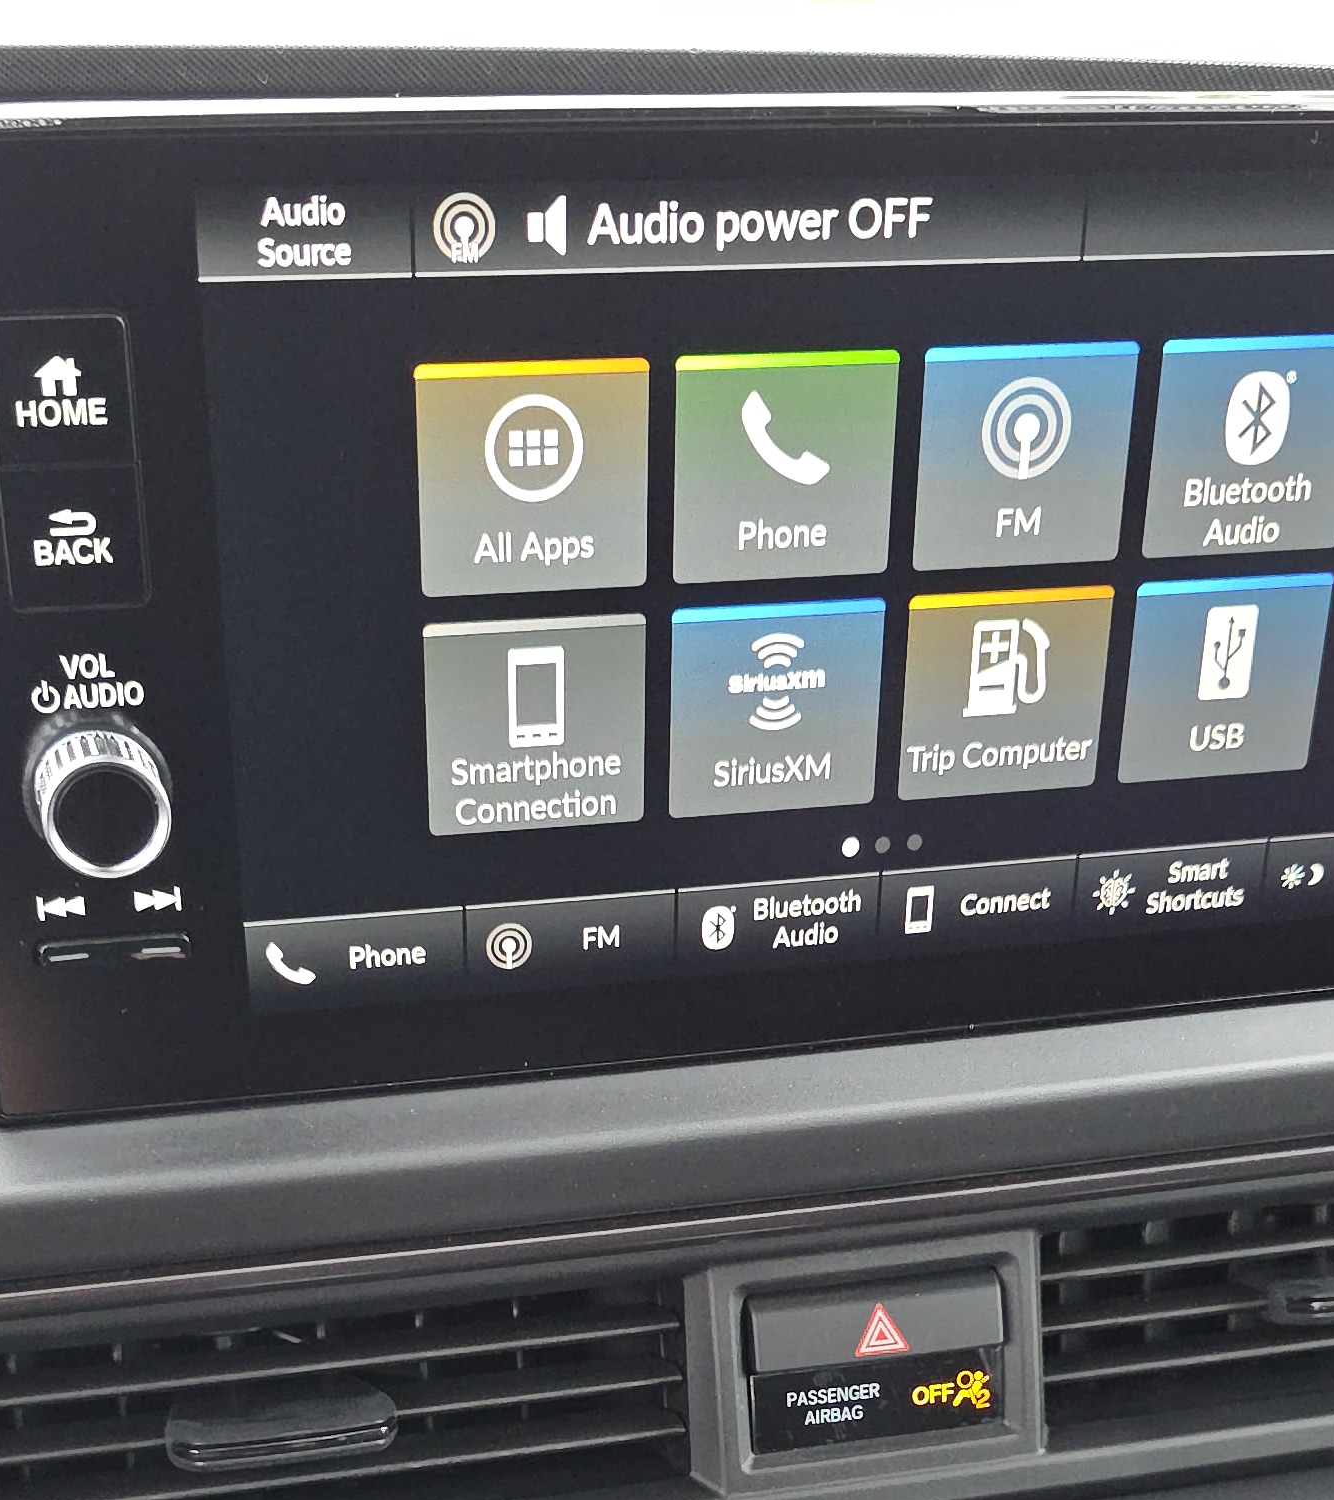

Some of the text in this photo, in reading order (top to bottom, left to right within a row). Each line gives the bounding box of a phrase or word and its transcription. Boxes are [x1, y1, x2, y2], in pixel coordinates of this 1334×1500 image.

[259, 194, 346, 228] Audio
[586, 196, 934, 252] Audio power OFF
[257, 236, 352, 268] Source
[450, 242, 480, 264] FM
[14, 396, 109, 428] HOME
[1183, 472, 1312, 508] Bluetooth
[738, 517, 827, 551] Phone
[995, 505, 1042, 538] FM
[1202, 515, 1280, 547] Audio
[33, 536, 114, 567] BACK
[473, 530, 595, 567] All Apps
[58, 652, 116, 680] VOL
[63, 680, 145, 710] AUDIO
[1189, 722, 1245, 752] USB
[451, 751, 622, 787] Smartphone
[713, 751, 832, 788] SiriusXM
[906, 735, 1094, 776] Trip Computer
[455, 791, 617, 827] Connection
[1167, 857, 1230, 884] Smart
[752, 889, 862, 923] Bluetooth
[960, 887, 1052, 917] Connect
[1145, 883, 1245, 915] Shortcuts
[582, 924, 620, 951] FM
[772, 921, 839, 949] Audio
[348, 943, 427, 970] Phone
[786, 1382, 881, 1408] PASSENGER
[911, 1381, 955, 1407] OFF
[804, 1404, 864, 1426] AIRBAG
